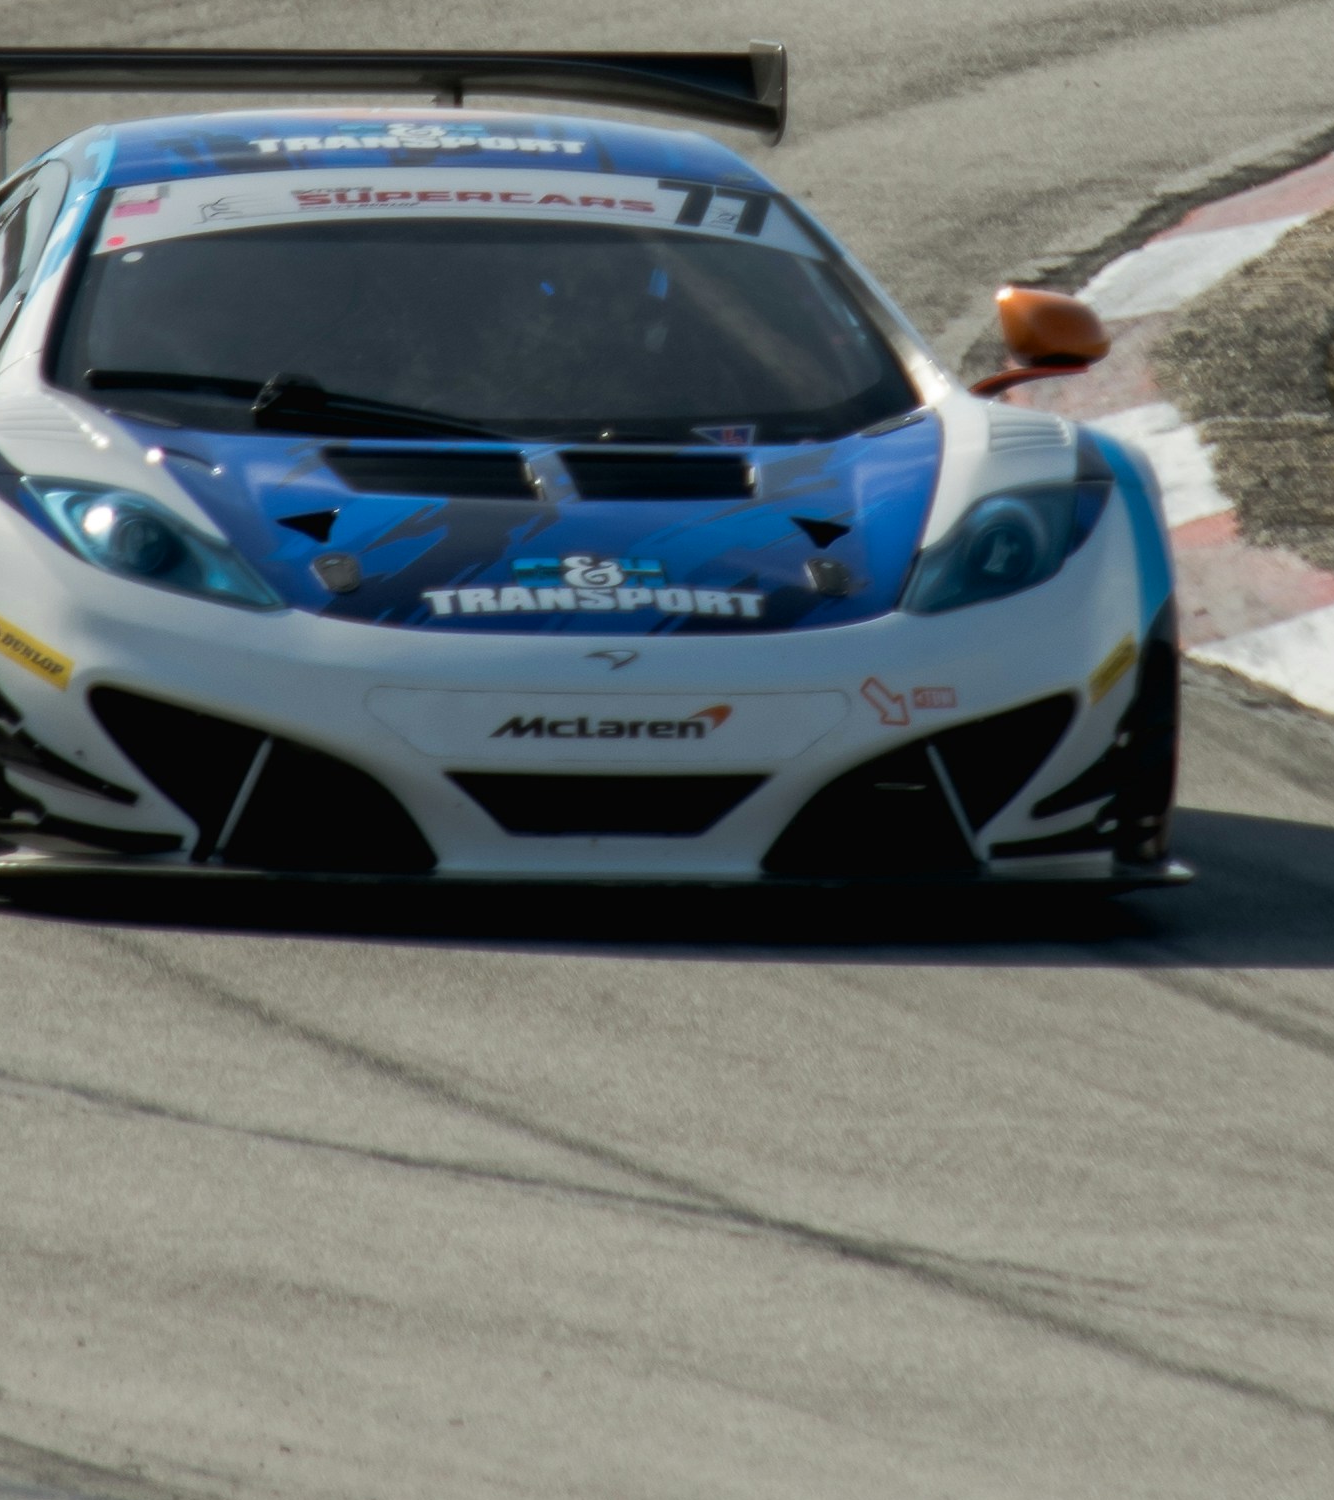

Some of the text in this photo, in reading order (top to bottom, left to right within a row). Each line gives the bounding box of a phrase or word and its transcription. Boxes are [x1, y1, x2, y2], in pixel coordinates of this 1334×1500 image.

[250, 135, 586, 154] TRANSPORT
[295, 190, 655, 213] SUPERCARS
[657, 178, 774, 238] 77
[421, 586, 764, 617] TRANSPORT
[1, 632, 64, 674] DUNLOP
[488, 715, 705, 739] McLaren
